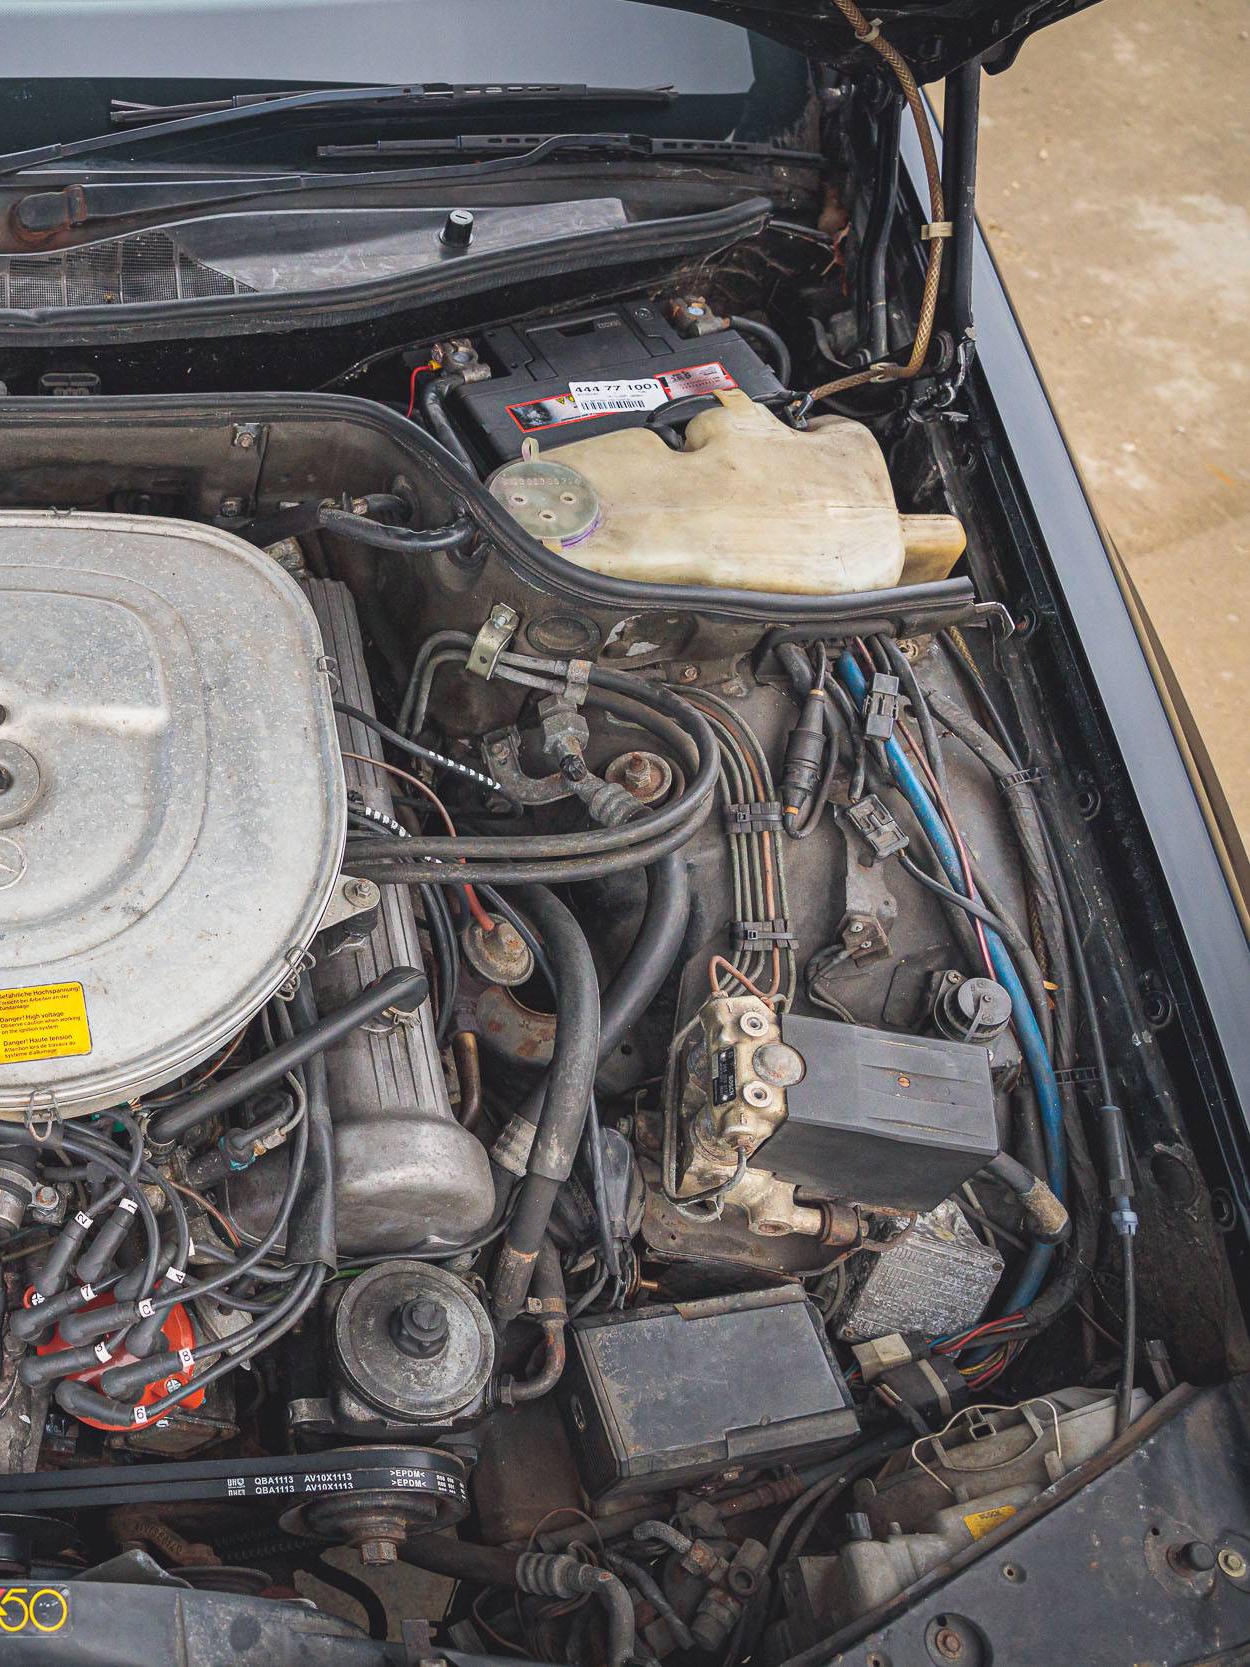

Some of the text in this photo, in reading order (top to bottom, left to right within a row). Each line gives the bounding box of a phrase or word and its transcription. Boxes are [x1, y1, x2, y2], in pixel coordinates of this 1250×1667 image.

[628, 383, 658, 391] 1001
[77, 1213, 88, 1224] 2
[175, 1271, 184, 1281] 4
[82, 1286, 90, 1297] 7
[181, 1351, 191, 1361] 8
[136, 1408, 145, 1420] 6
[254, 1475, 294, 1485] QBA1113
[304, 1473, 352, 1483] AV10X1113
[255, 1485, 295, 1495] QBA1113
[305, 1482, 354, 1492] AV10X1113
